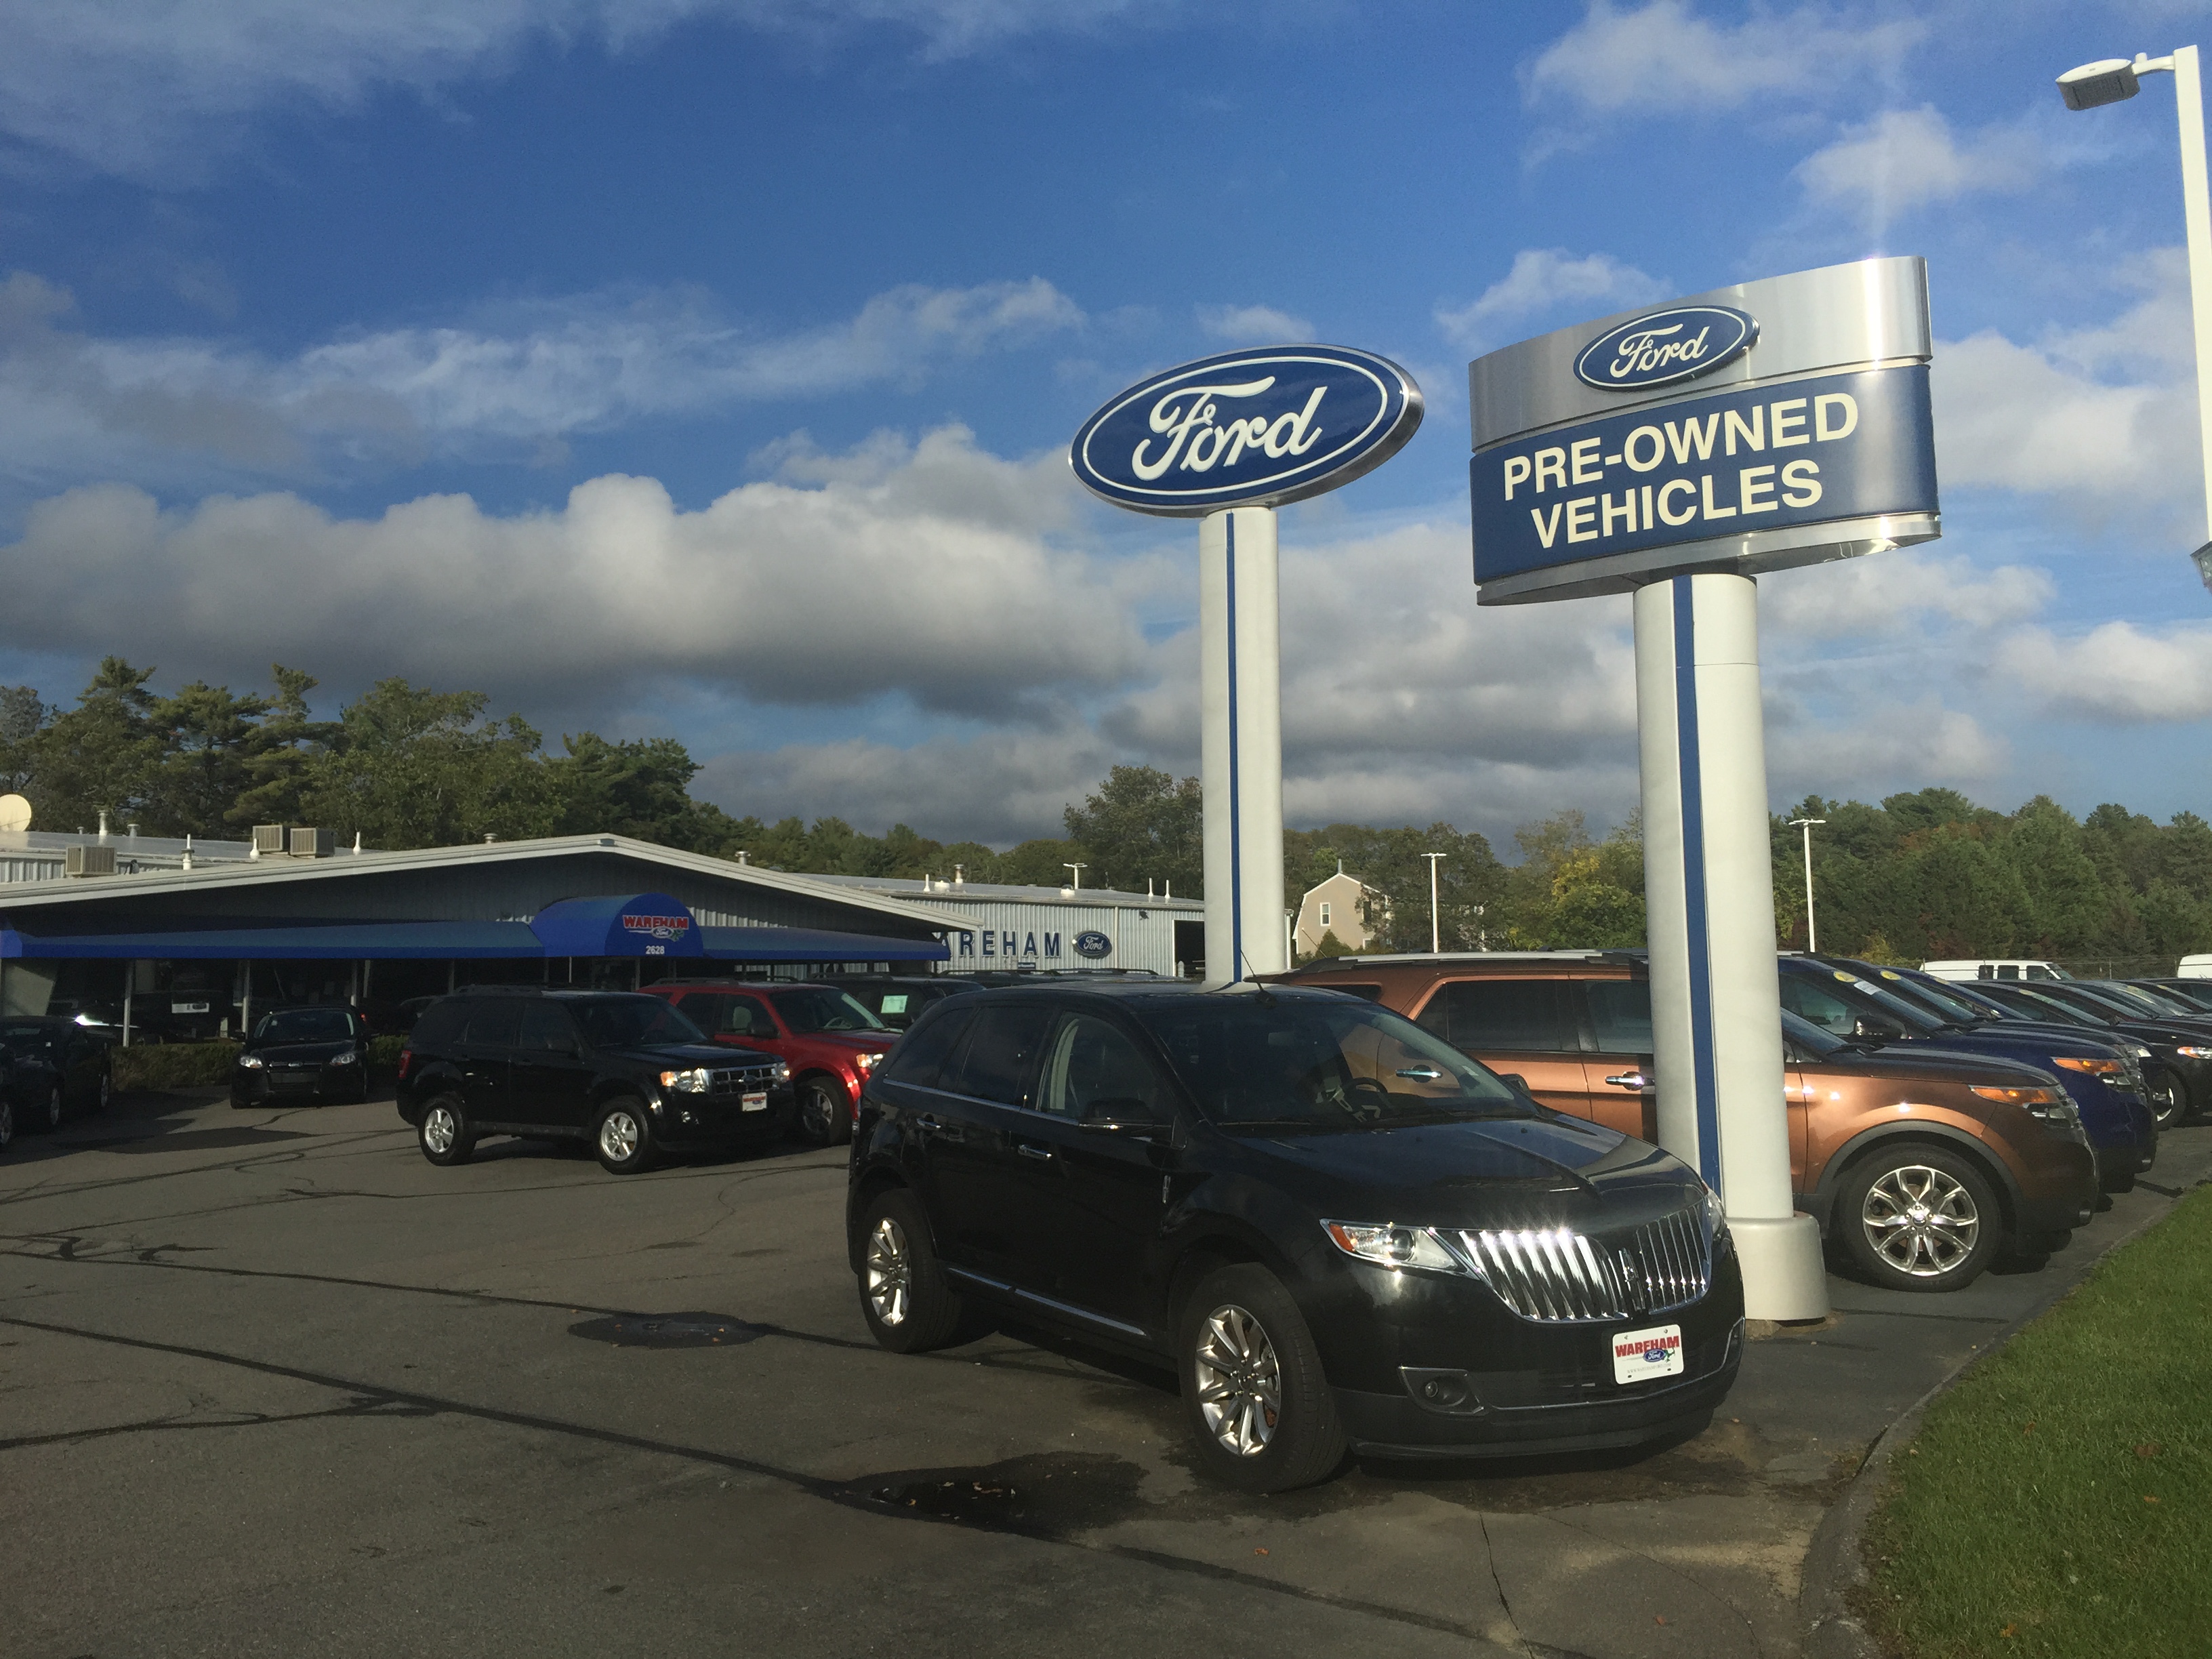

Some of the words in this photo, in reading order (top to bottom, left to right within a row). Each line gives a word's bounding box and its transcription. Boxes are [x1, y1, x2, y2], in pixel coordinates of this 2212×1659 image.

[1610, 323, 1708, 377] Ford
[1131, 375, 1328, 481] Ford
[1503, 392, 1859, 501] PRE-OWNED
[1530, 459, 1823, 549] VEHICLES
[623, 915, 689, 930] WAREHAM
[645, 945, 665, 955] 2628
[1083, 936, 1104, 950] Ford
[1615, 1336, 1679, 1357] WAREHAM
[1647, 1351, 1661, 1359] Ford
